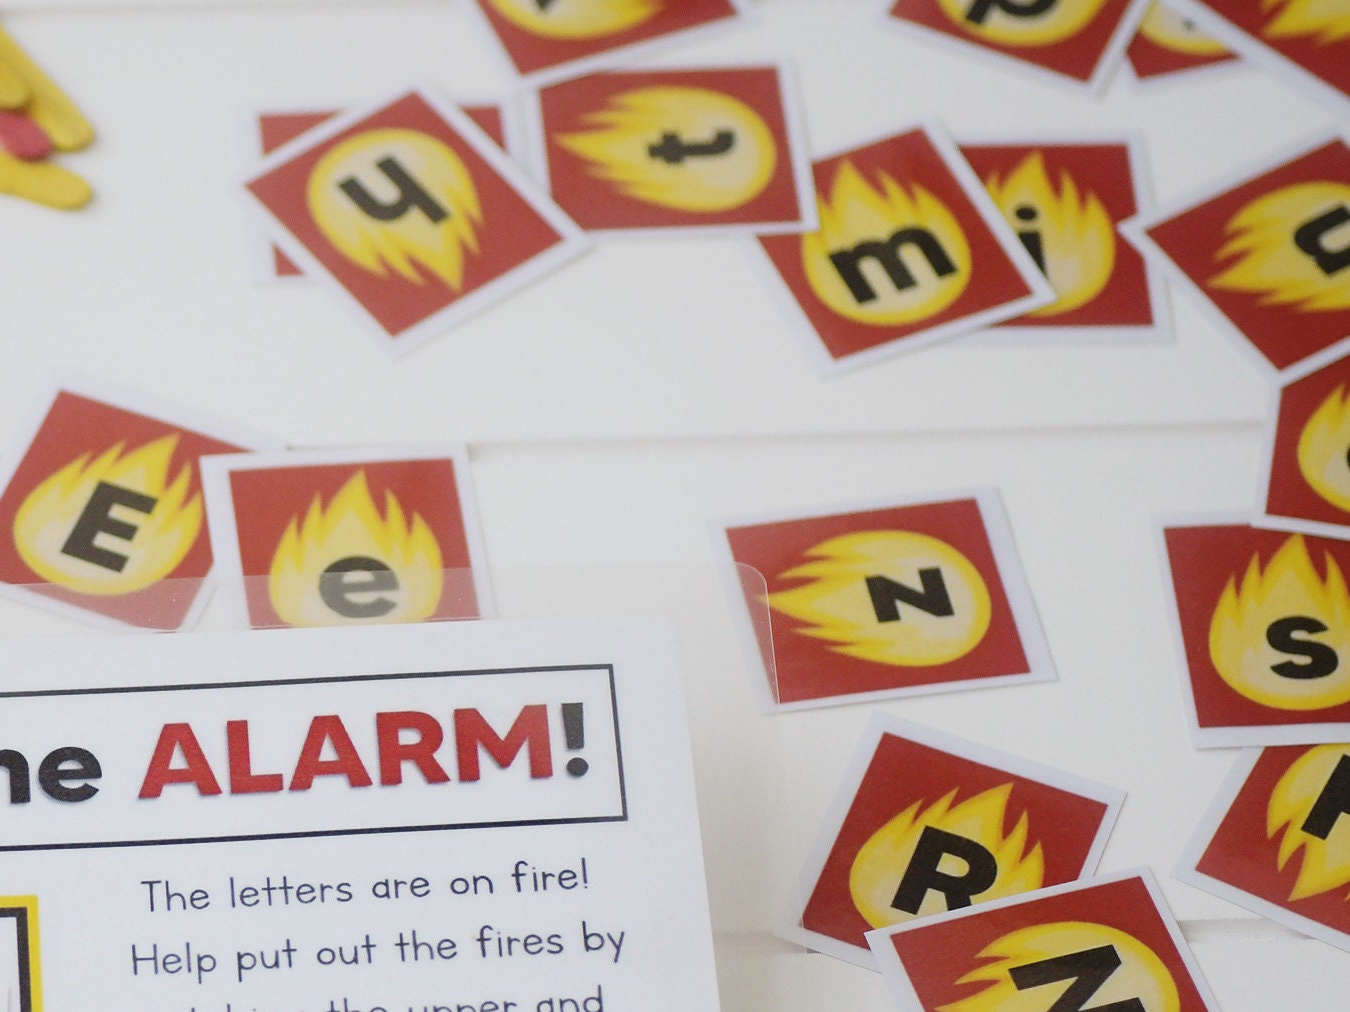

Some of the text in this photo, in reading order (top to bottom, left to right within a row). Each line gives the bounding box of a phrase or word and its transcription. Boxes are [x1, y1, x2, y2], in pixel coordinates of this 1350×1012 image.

[649, 132, 734, 163] t
[829, 227, 957, 304] m
[62, 482, 156, 572] E
[318, 555, 400, 619] e
[138, 702, 588, 800] ALARM!
[141, 858, 587, 912] The letters are on fire!
[891, 826, 997, 915] R
[132, 921, 624, 984] Help put out the fires by
